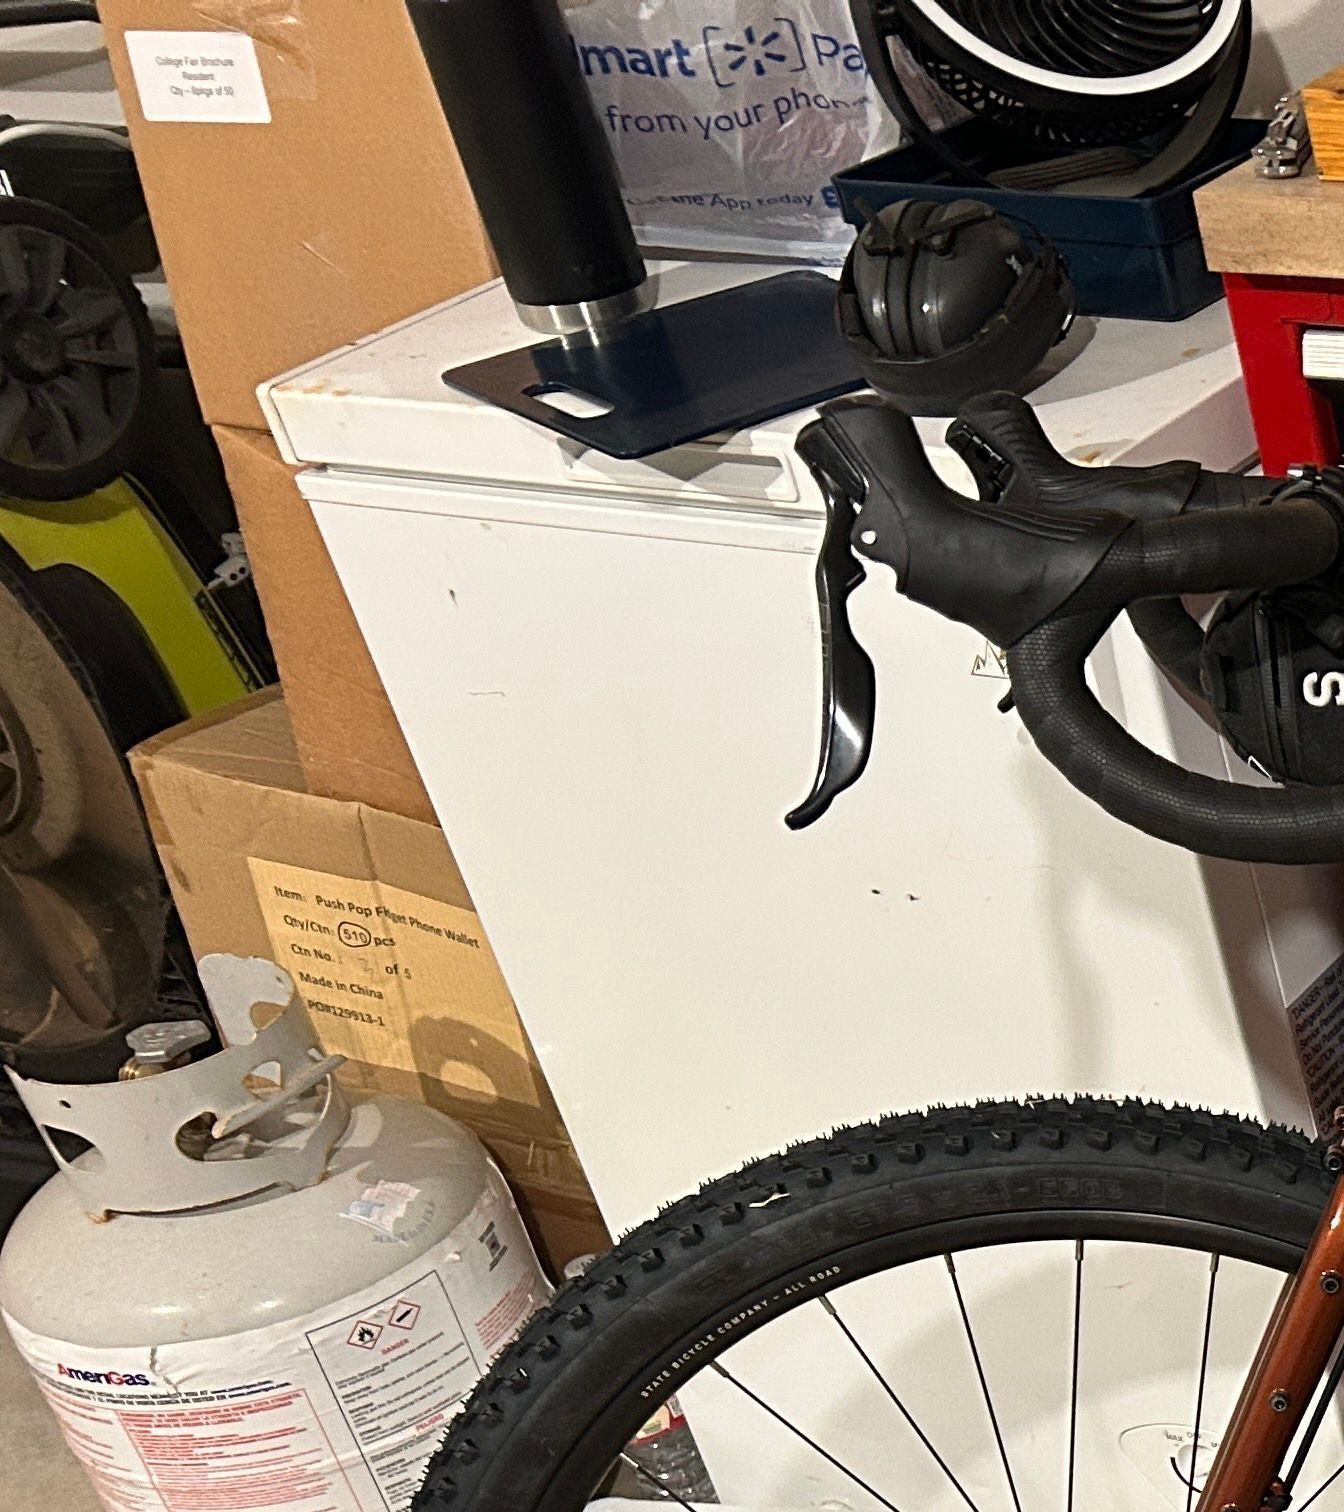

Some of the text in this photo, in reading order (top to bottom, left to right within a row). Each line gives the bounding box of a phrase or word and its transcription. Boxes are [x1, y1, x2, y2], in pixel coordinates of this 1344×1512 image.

[811, 33, 867, 72] Pa
[606, 105, 687, 133] from
[693, 103, 764, 140] your
[315, 895, 345, 911] Push
[348, 902, 373, 917] Pop
[408, 915, 443, 936] Phone
[444, 927, 480, 949] Wallet
[342, 927, 370, 944] 510
[373, 935, 396, 947] pcs
[290, 943, 307, 957] Ctn
[385, 964, 400, 976] of
[403, 967, 412, 980] 5
[298, 971, 384, 1000] Made in China
[641, 1370, 671, 1399] STATE
[671, 1334, 716, 1369] BICYCLE
[717, 1299, 769, 1335] COMPANY
[784, 1281, 806, 1296] ALL
[809, 1265, 841, 1283] ROAD
